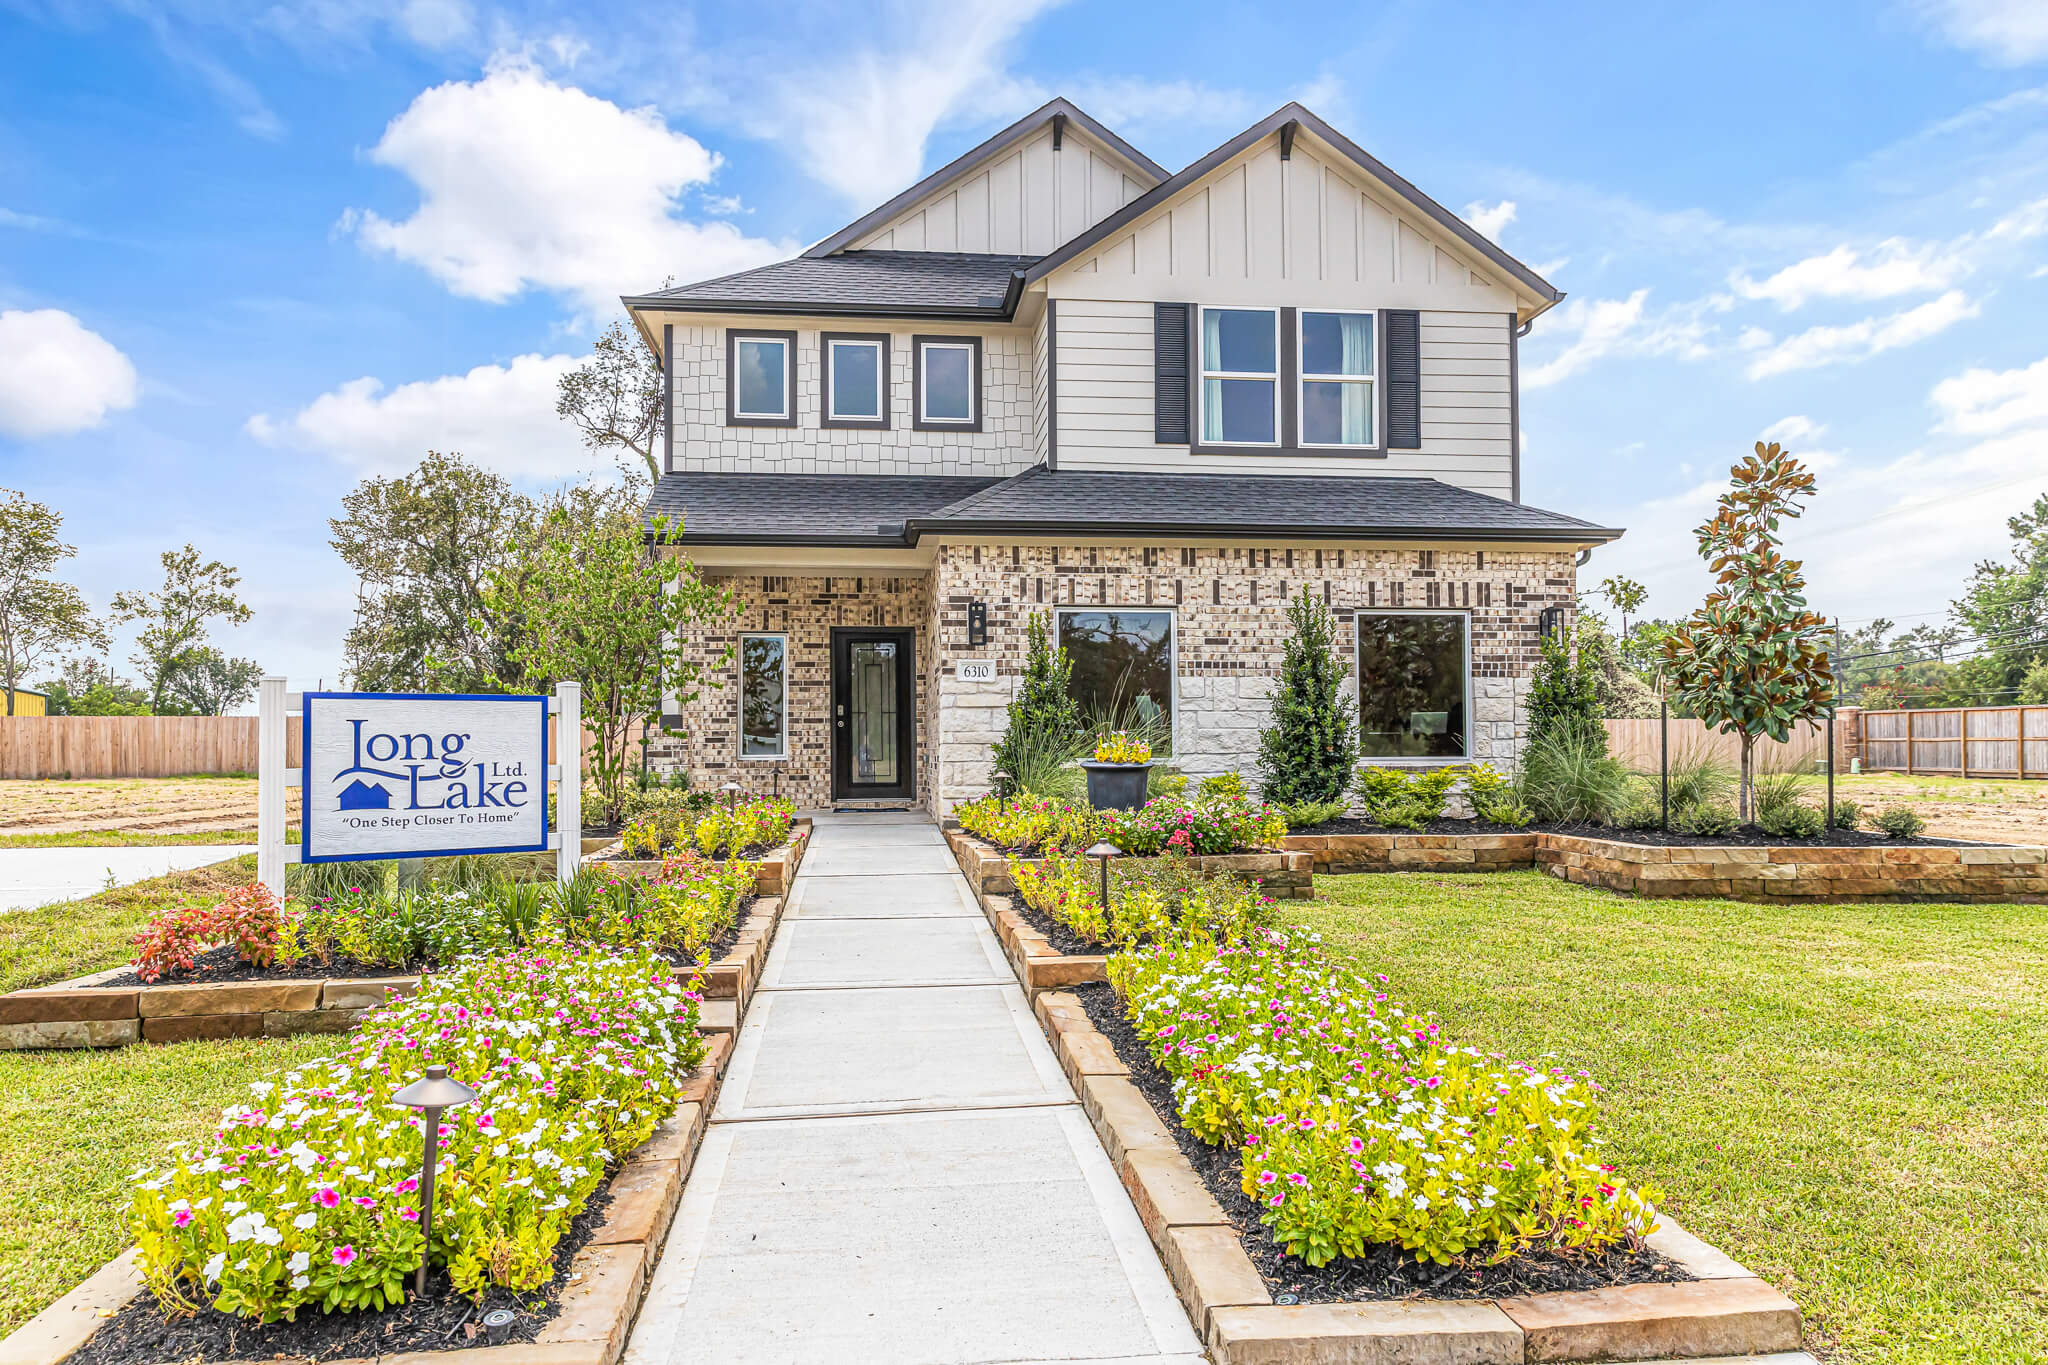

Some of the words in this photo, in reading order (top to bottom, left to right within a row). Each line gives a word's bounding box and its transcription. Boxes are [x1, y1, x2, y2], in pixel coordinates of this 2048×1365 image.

[963, 665, 989, 678] 6310
[345, 719, 472, 779] Long
[492, 761, 528, 777] Ltd.
[403, 762, 528, 810] Lake
[381, 816, 410, 829] Step
[414, 814, 455, 826] Closer
[457, 813, 474, 824] To
